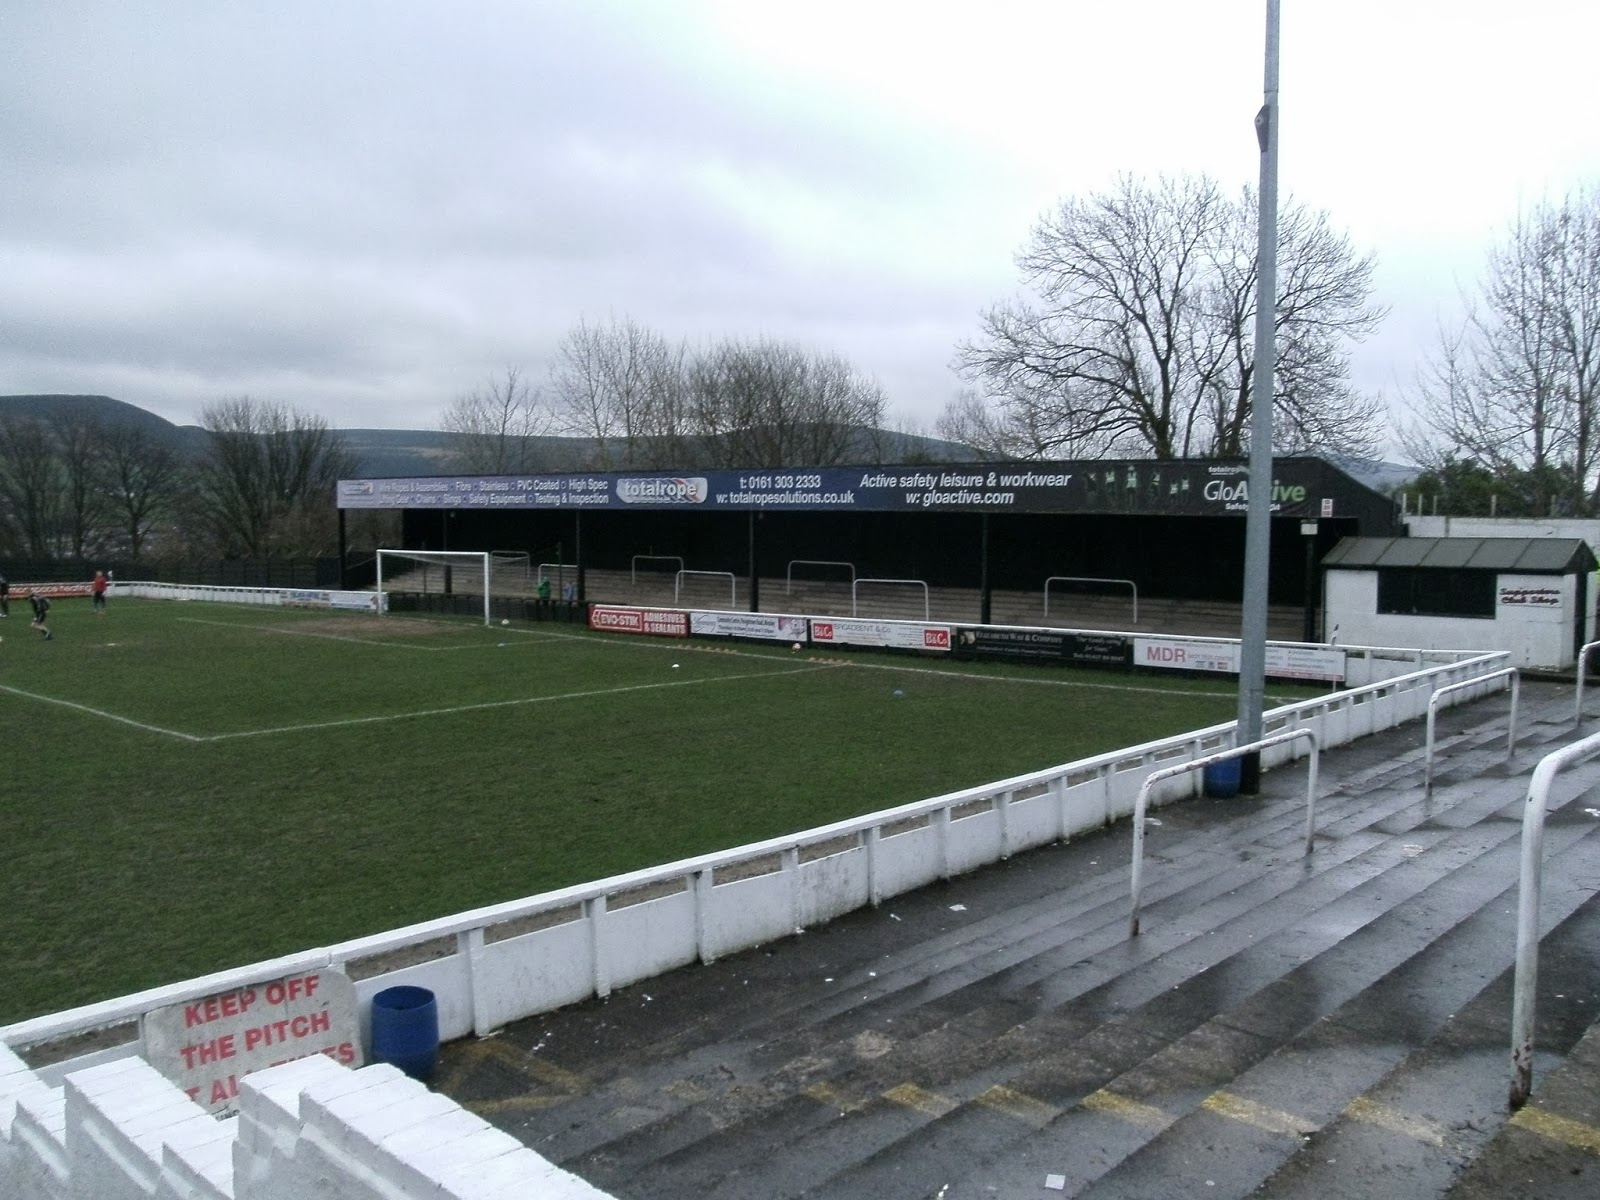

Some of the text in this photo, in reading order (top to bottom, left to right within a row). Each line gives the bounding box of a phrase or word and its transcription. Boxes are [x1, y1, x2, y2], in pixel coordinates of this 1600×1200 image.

[479, 480, 509, 492] Stainless
[517, 479, 532, 491] PVC
[533, 479, 560, 491] Coated
[568, 478, 589, 492] High
[590, 478, 608, 492] Spec
[748, 476, 773, 489] 0161
[775, 475, 794, 488] 303
[796, 475, 821, 488] 2333
[860, 472, 1072, 491] Active safety leisure & workwear
[624, 481, 697, 500] totalrope
[729, 490, 855, 506] totalropesolutions.co.uk
[923, 490, 1014, 507] gloactive.com
[1203, 479, 1306, 502] GloAive
[469, 493, 490, 506] Safety
[490, 493, 526, 506] Equipment
[535, 493, 560, 506] Testing
[561, 493, 568, 504] &
[568, 493, 609, 506] Inspection
[600, 612, 640, 627] EVO-STIK
[643, 611, 685, 624] ADHESIVES
[643, 623, 686, 635] & SEALANTS
[1147, 646, 1187, 662] MDR
[184, 974, 319, 1029] KEEP OFF
[180, 1034, 237, 1071] THE
[245, 1009, 331, 1052] PITCH
